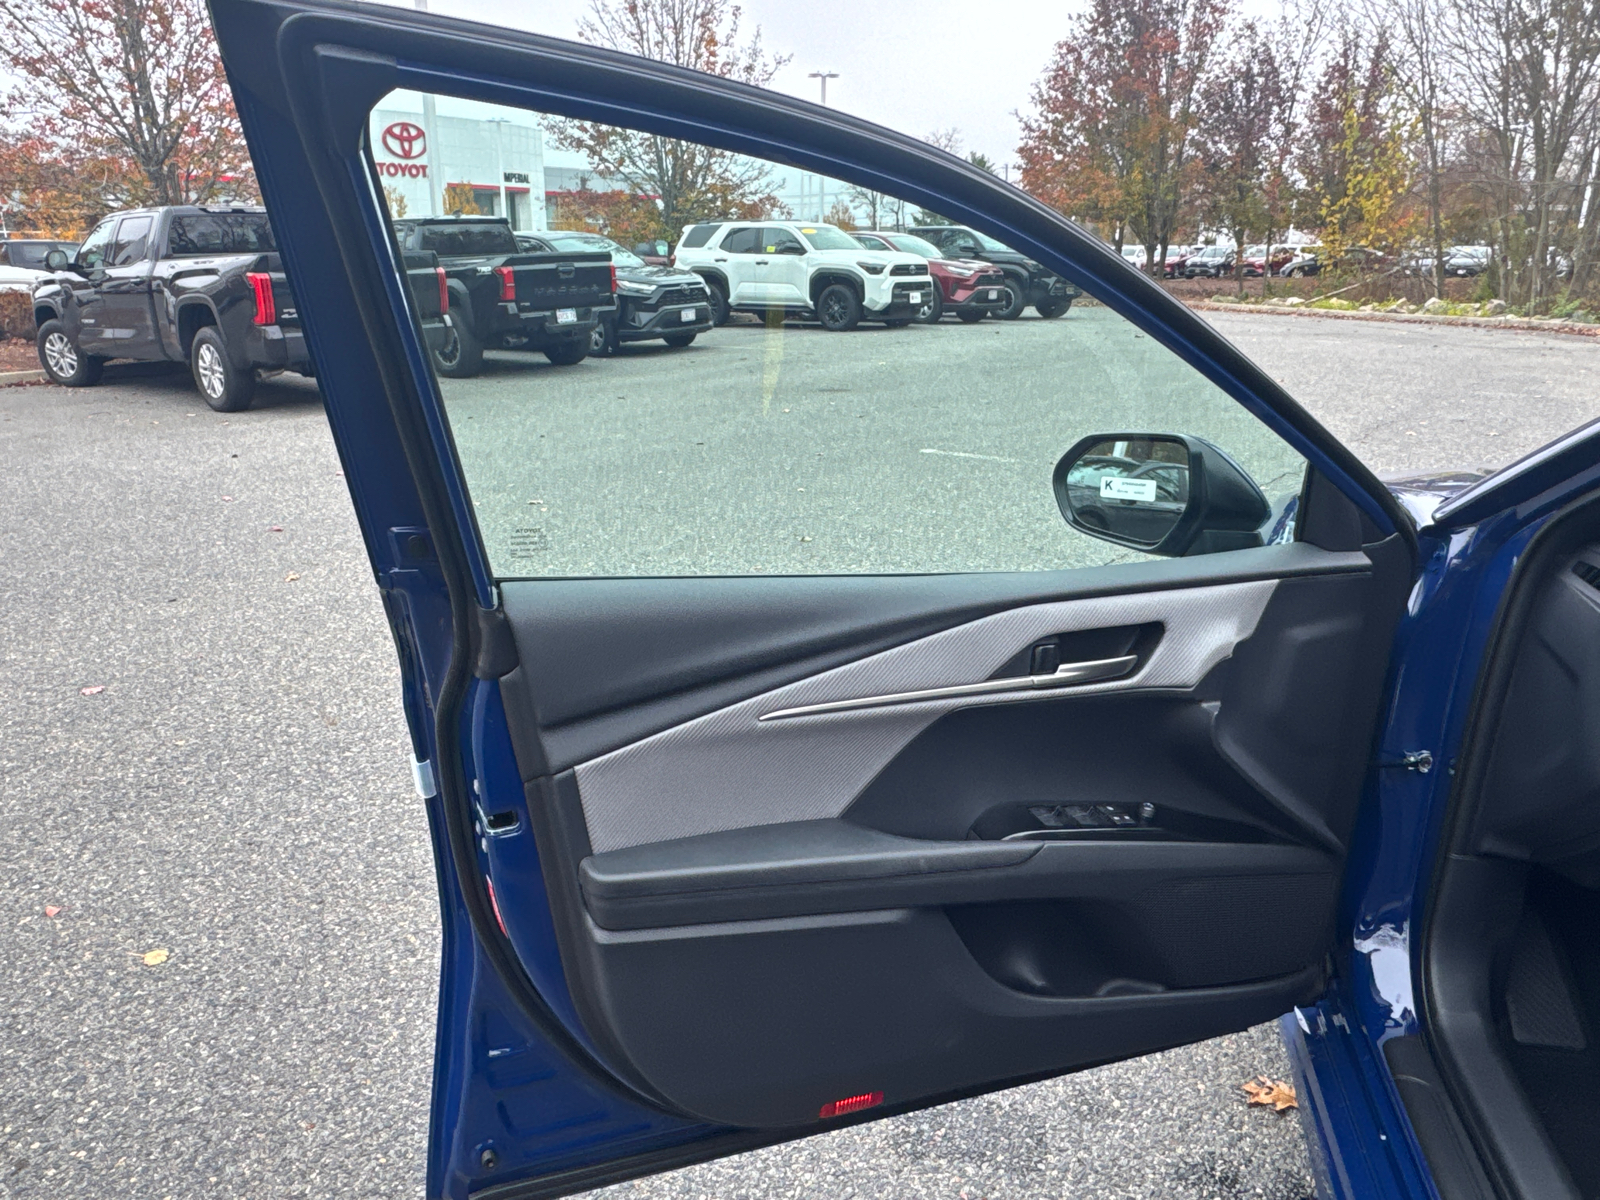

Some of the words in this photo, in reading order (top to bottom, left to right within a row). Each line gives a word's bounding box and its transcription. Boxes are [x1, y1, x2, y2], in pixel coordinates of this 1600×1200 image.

[376, 162, 429, 179] TOYOT
[503, 172, 531, 184] MPERIAL
[1105, 480, 1113, 491] K
